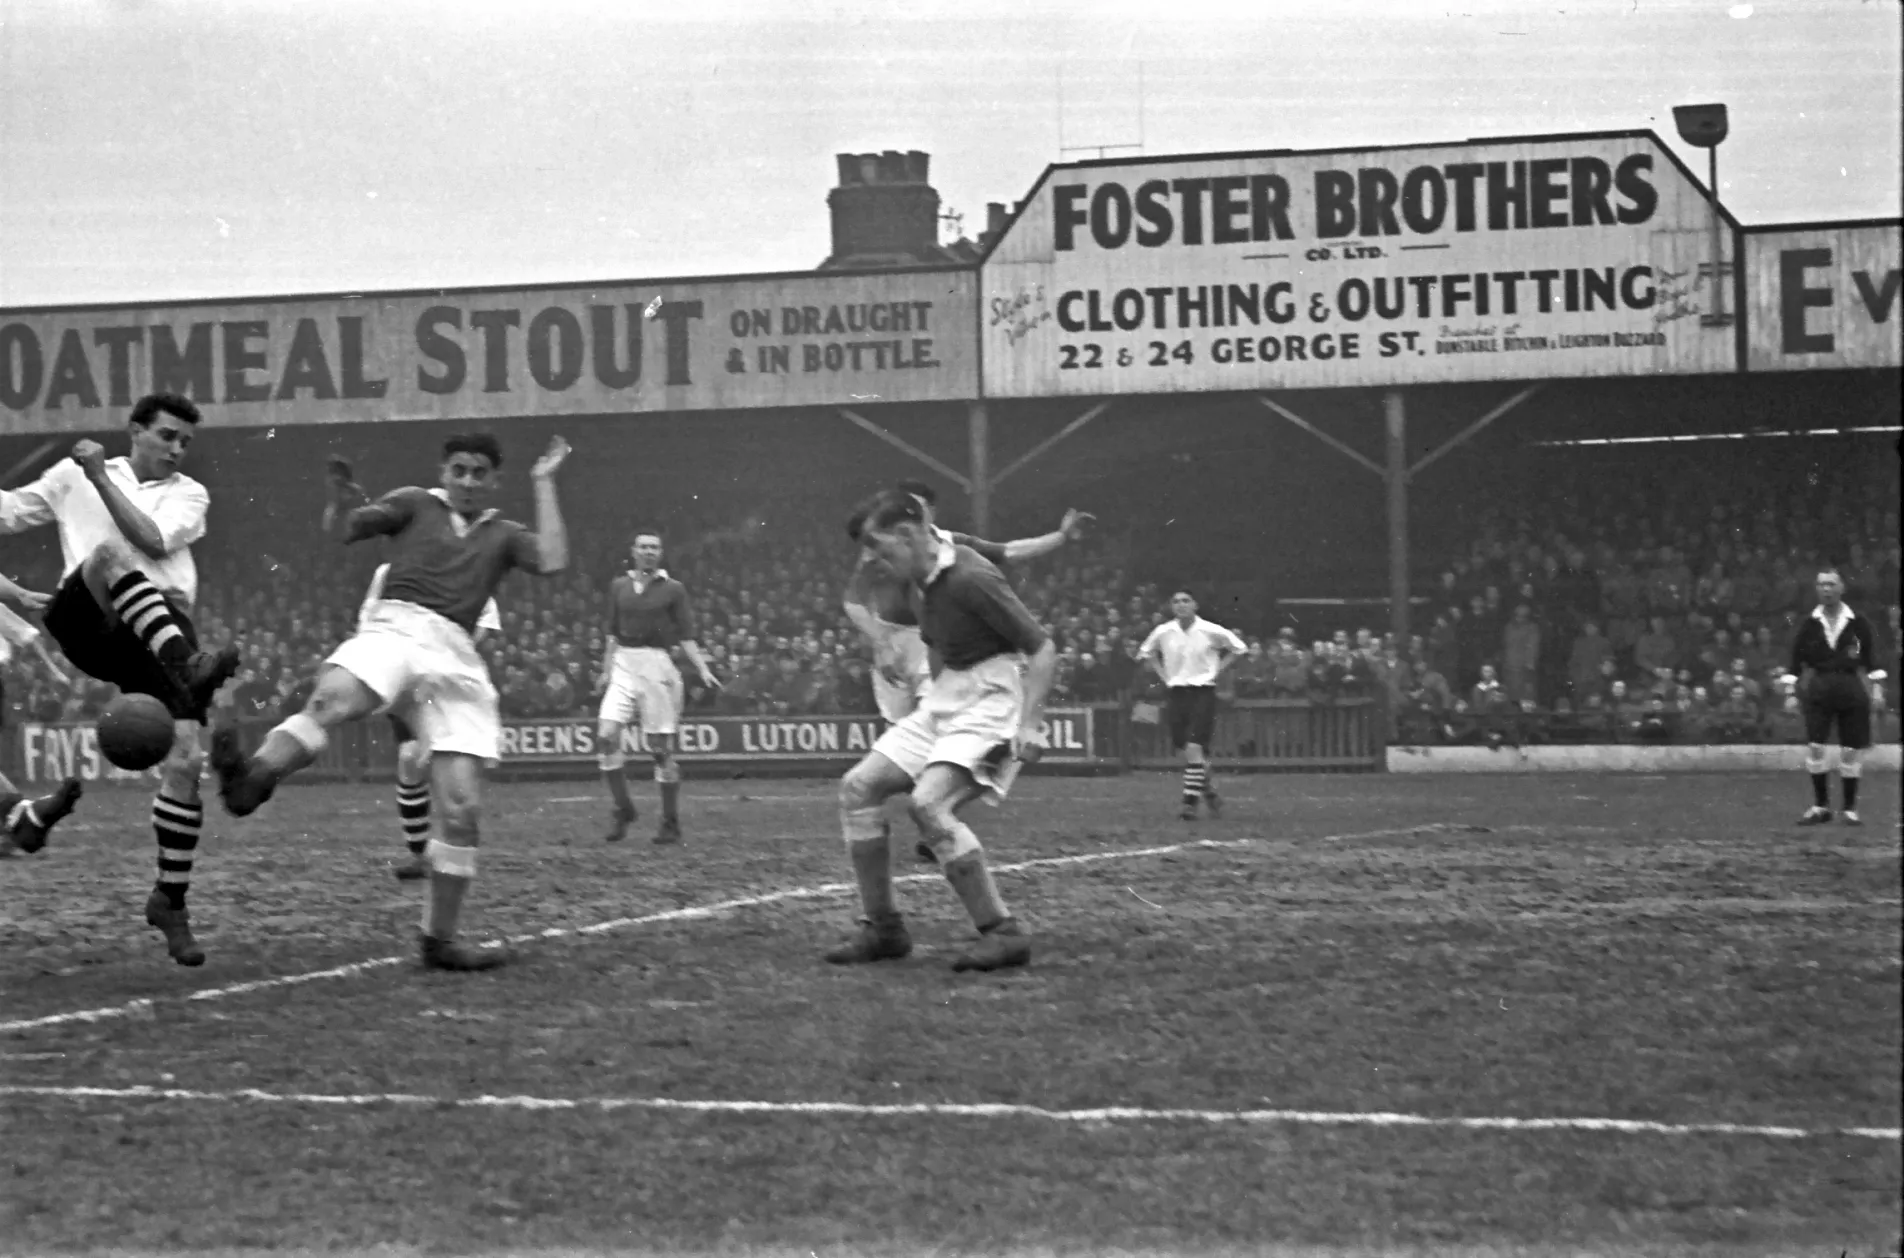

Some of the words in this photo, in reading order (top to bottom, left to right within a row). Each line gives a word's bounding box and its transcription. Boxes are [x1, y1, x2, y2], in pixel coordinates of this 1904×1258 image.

[1053, 174, 1296, 251] FOSTER
[1314, 154, 1659, 239] BROTHERS
[1056, 281, 1296, 332] CLOTHING
[1308, 292, 1330, 324] &
[1337, 266, 1658, 322] OUTFITTING
[730, 308, 772, 338] ON
[782, 301, 934, 337] DRAUGHT
[0, 316, 389, 410] OATMEAL
[415, 300, 704, 395] STOUT
[725, 347, 747, 374] &
[758, 345, 790, 373] IN
[803, 339, 941, 373] BOTTLE.
[1058, 343, 1104, 370] 22
[1116, 347, 1134, 368] &
[1148, 340, 1195, 367] 24
[1211, 332, 1360, 364] GEORGE
[1379, 331, 1426, 359] ST.
[741, 722, 839, 752] LUTON
